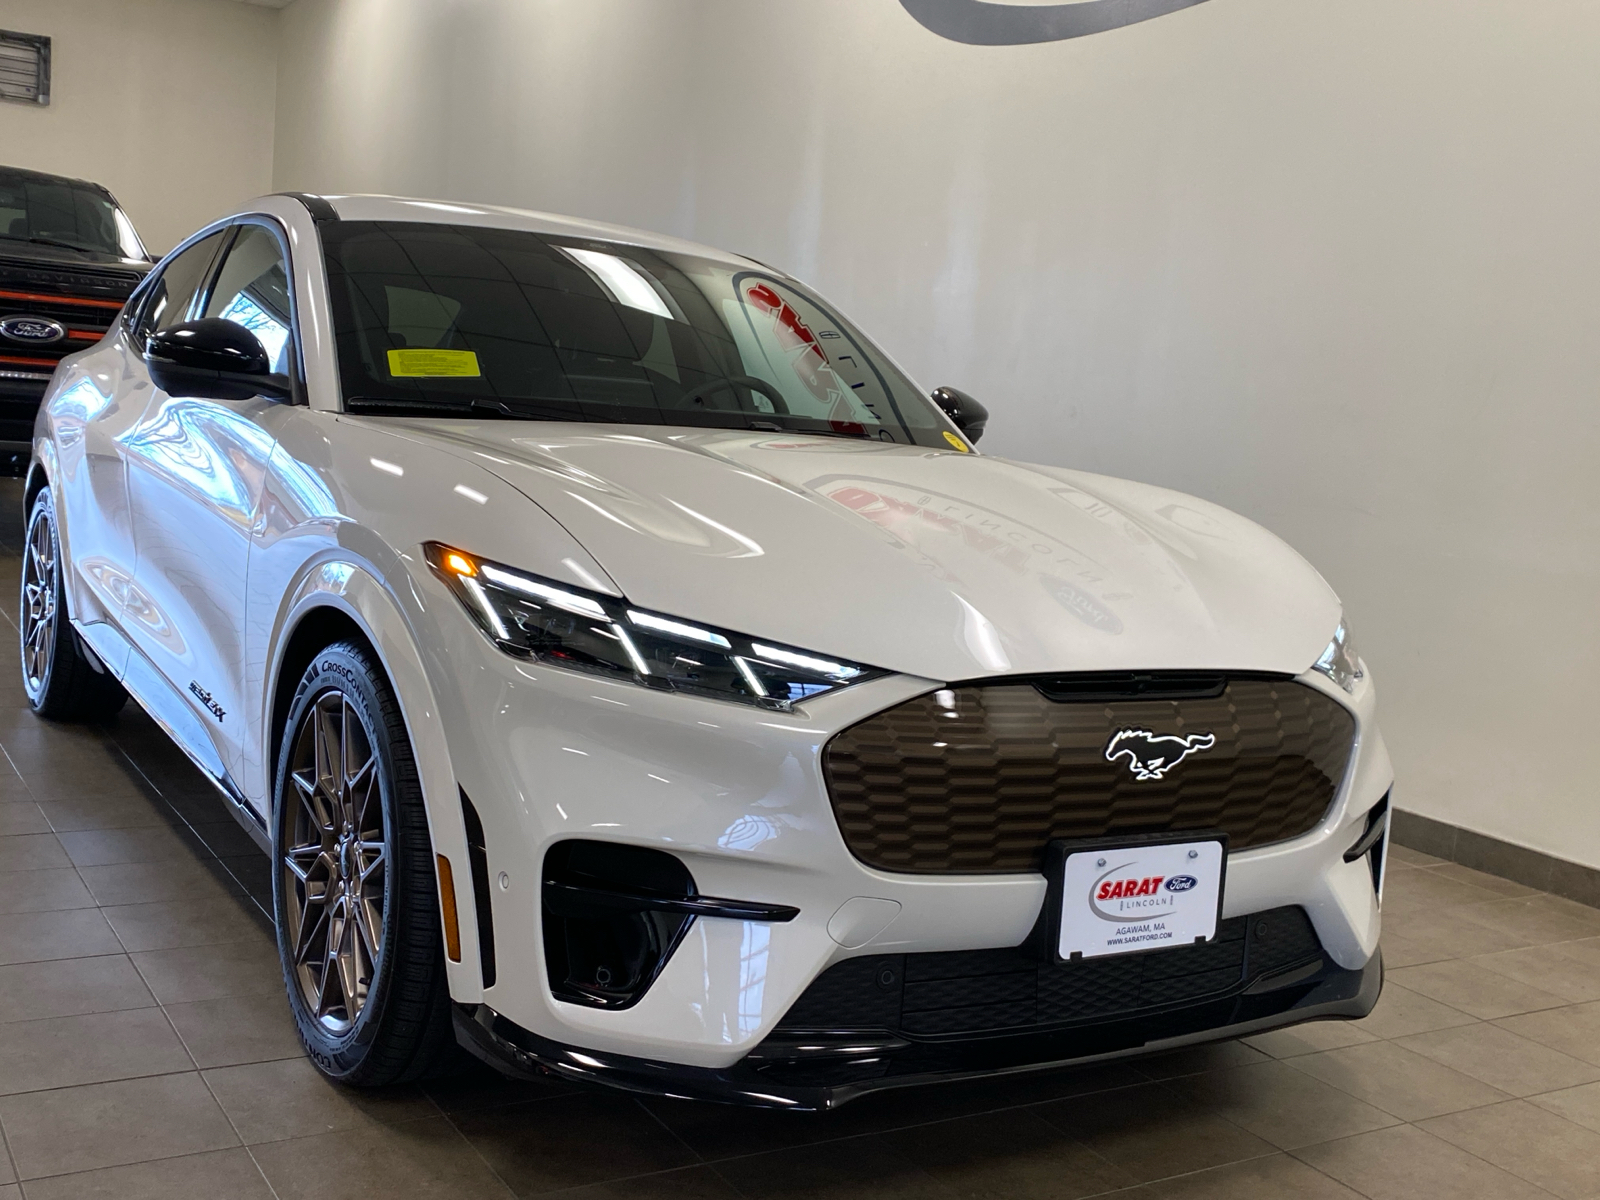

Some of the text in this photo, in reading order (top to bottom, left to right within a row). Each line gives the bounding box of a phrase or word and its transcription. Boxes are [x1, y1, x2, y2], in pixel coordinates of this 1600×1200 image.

[1096, 875, 1165, 901] SARAT
[1126, 898, 1167, 909] LINCOLN
[1115, 922, 1166, 936] AGAWAM, MA
[1106, 932, 1173, 946] WWW.SARATFORD.COM
